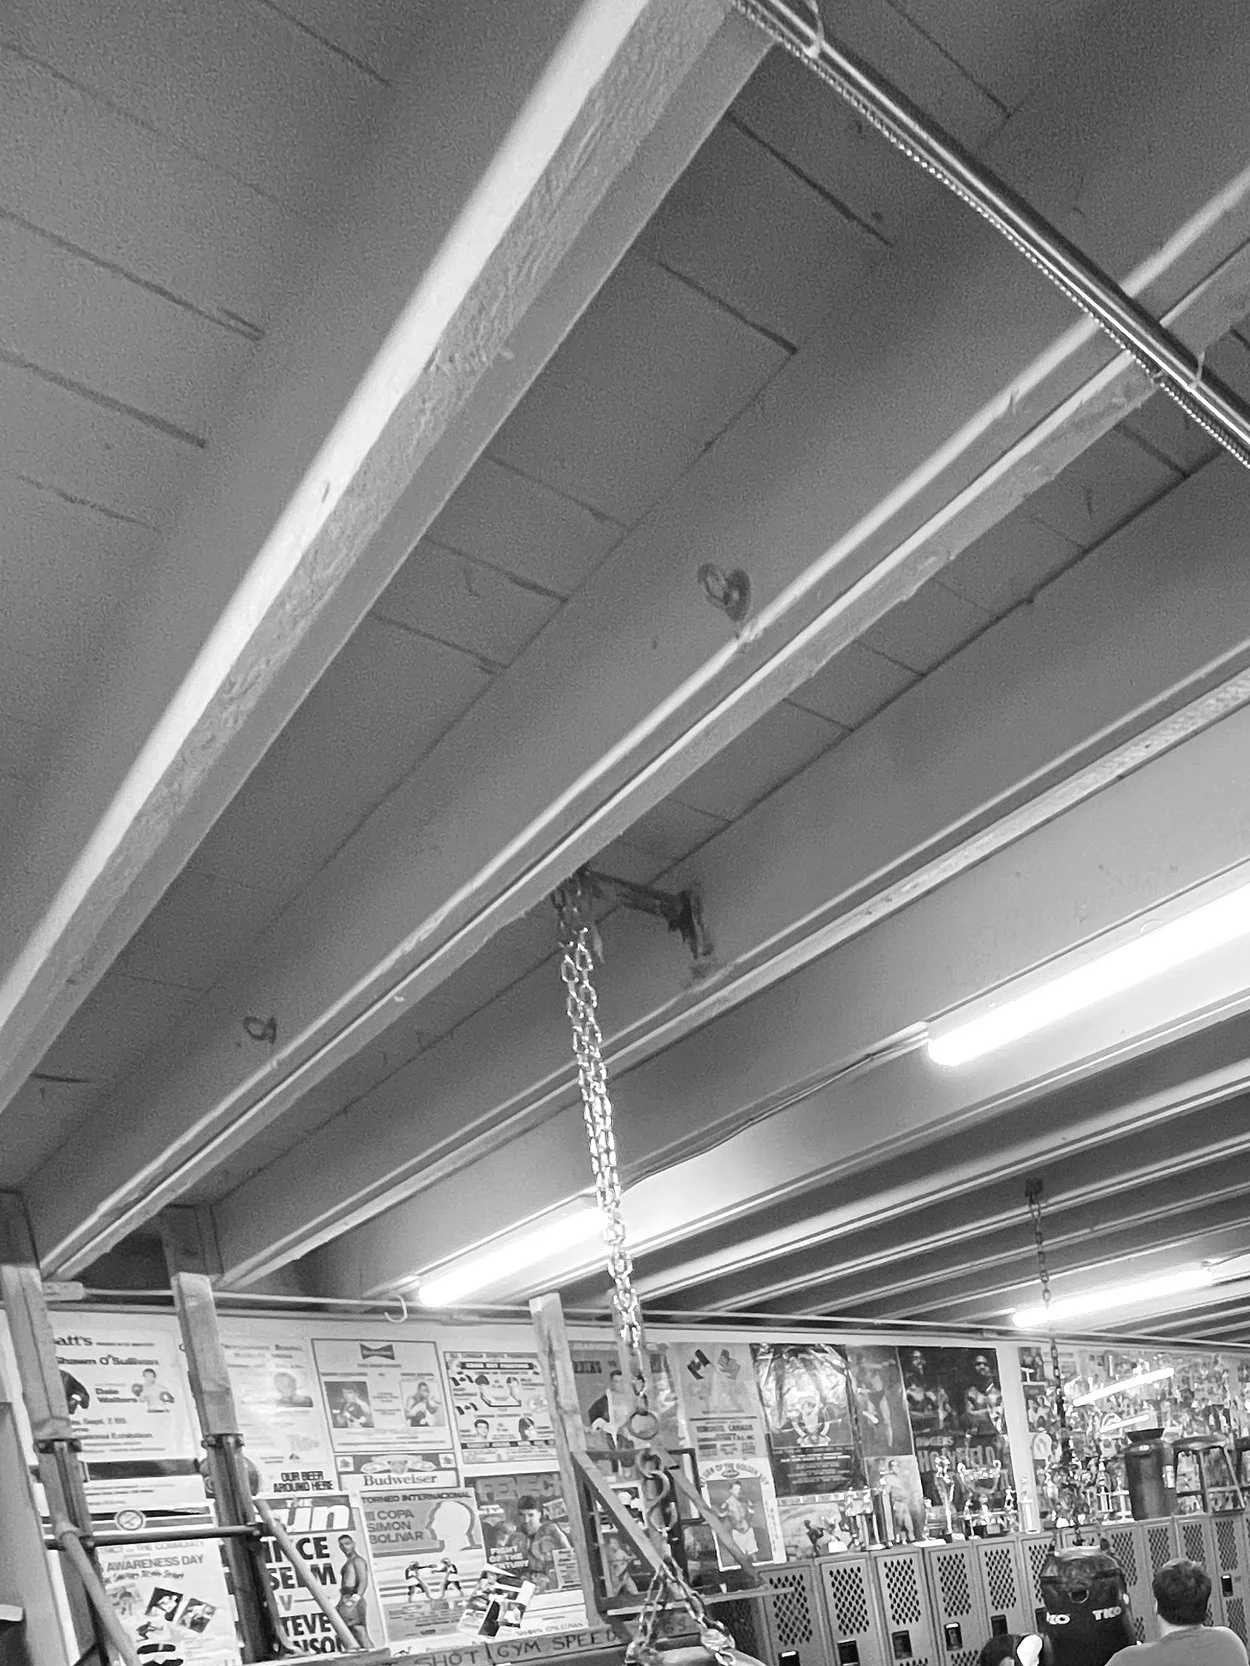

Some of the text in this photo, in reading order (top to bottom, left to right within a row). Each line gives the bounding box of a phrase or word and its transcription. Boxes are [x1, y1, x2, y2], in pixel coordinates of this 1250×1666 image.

[363, 1475, 437, 1487] Budweiser
[377, 1510, 415, 1520] COPA
[367, 1521, 412, 1533] SIMON
[369, 1531, 424, 1545] BOLIVAR
[106, 1553, 204, 1572] AWARENESS DAY
[1092, 1606, 1122, 1620] TKO
[497, 1641, 541, 1658] GYM
[552, 1630, 617, 1650] SPEED
